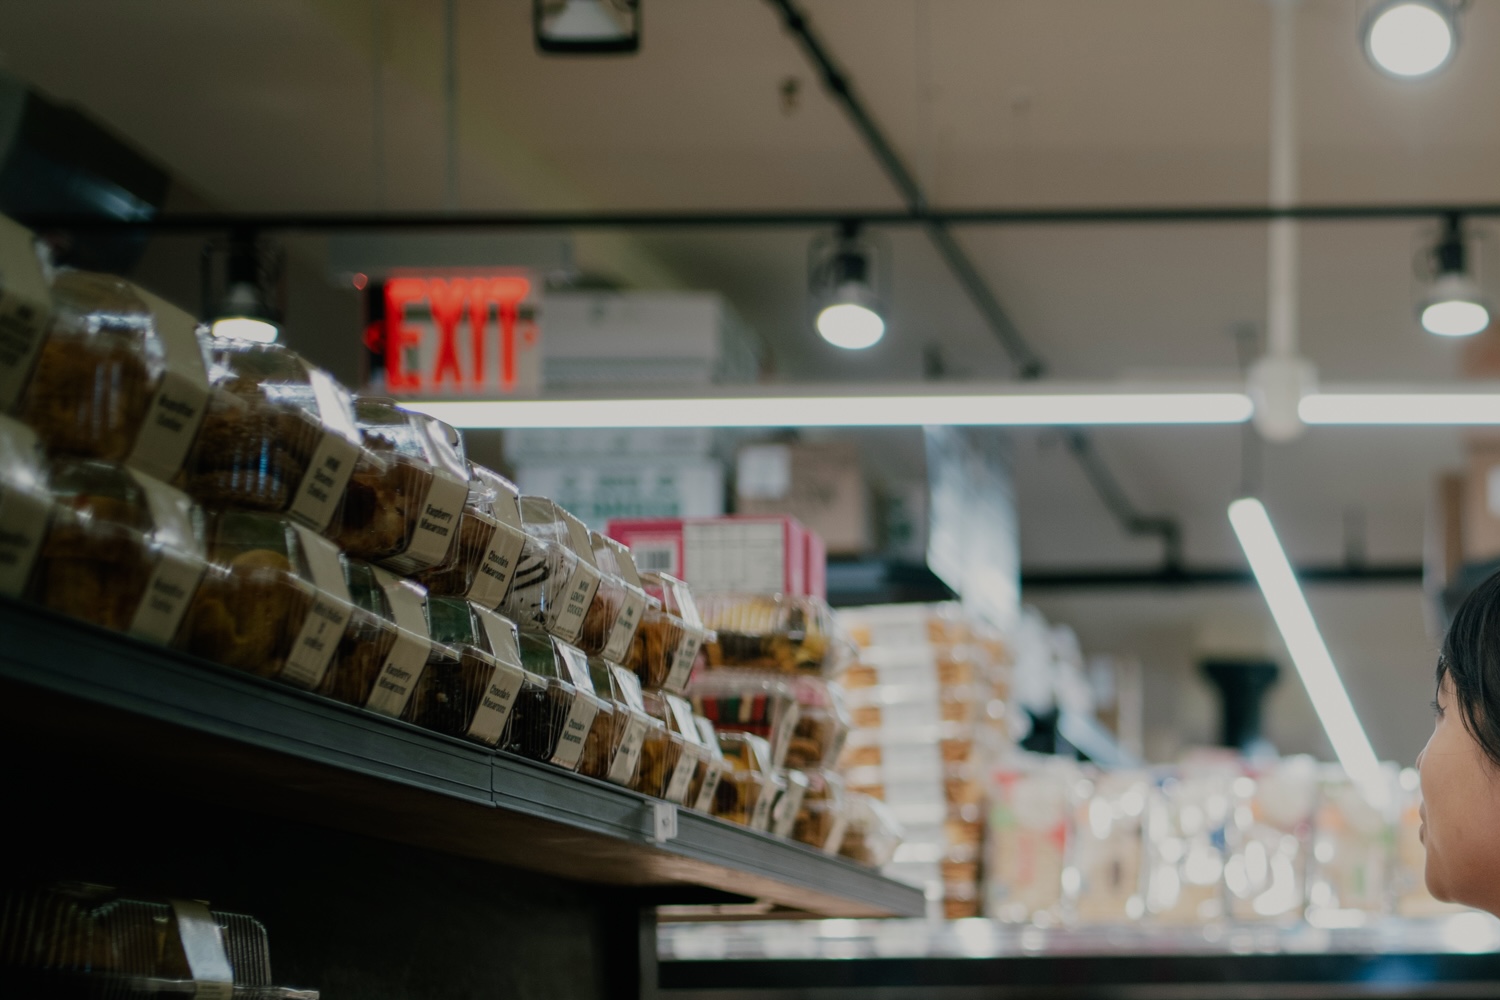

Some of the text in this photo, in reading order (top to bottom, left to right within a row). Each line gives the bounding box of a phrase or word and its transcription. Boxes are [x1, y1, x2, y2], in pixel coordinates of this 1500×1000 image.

[384, 276, 531, 393] EXIT
[426, 504, 453, 524] Raspberry
[419, 517, 449, 537] Macaroons
[488, 550, 509, 568] Chocolate
[481, 562, 506, 582] Macaroons
[489, 684, 511, 701] Chocolate
[482, 696, 507, 714] Macaroons
